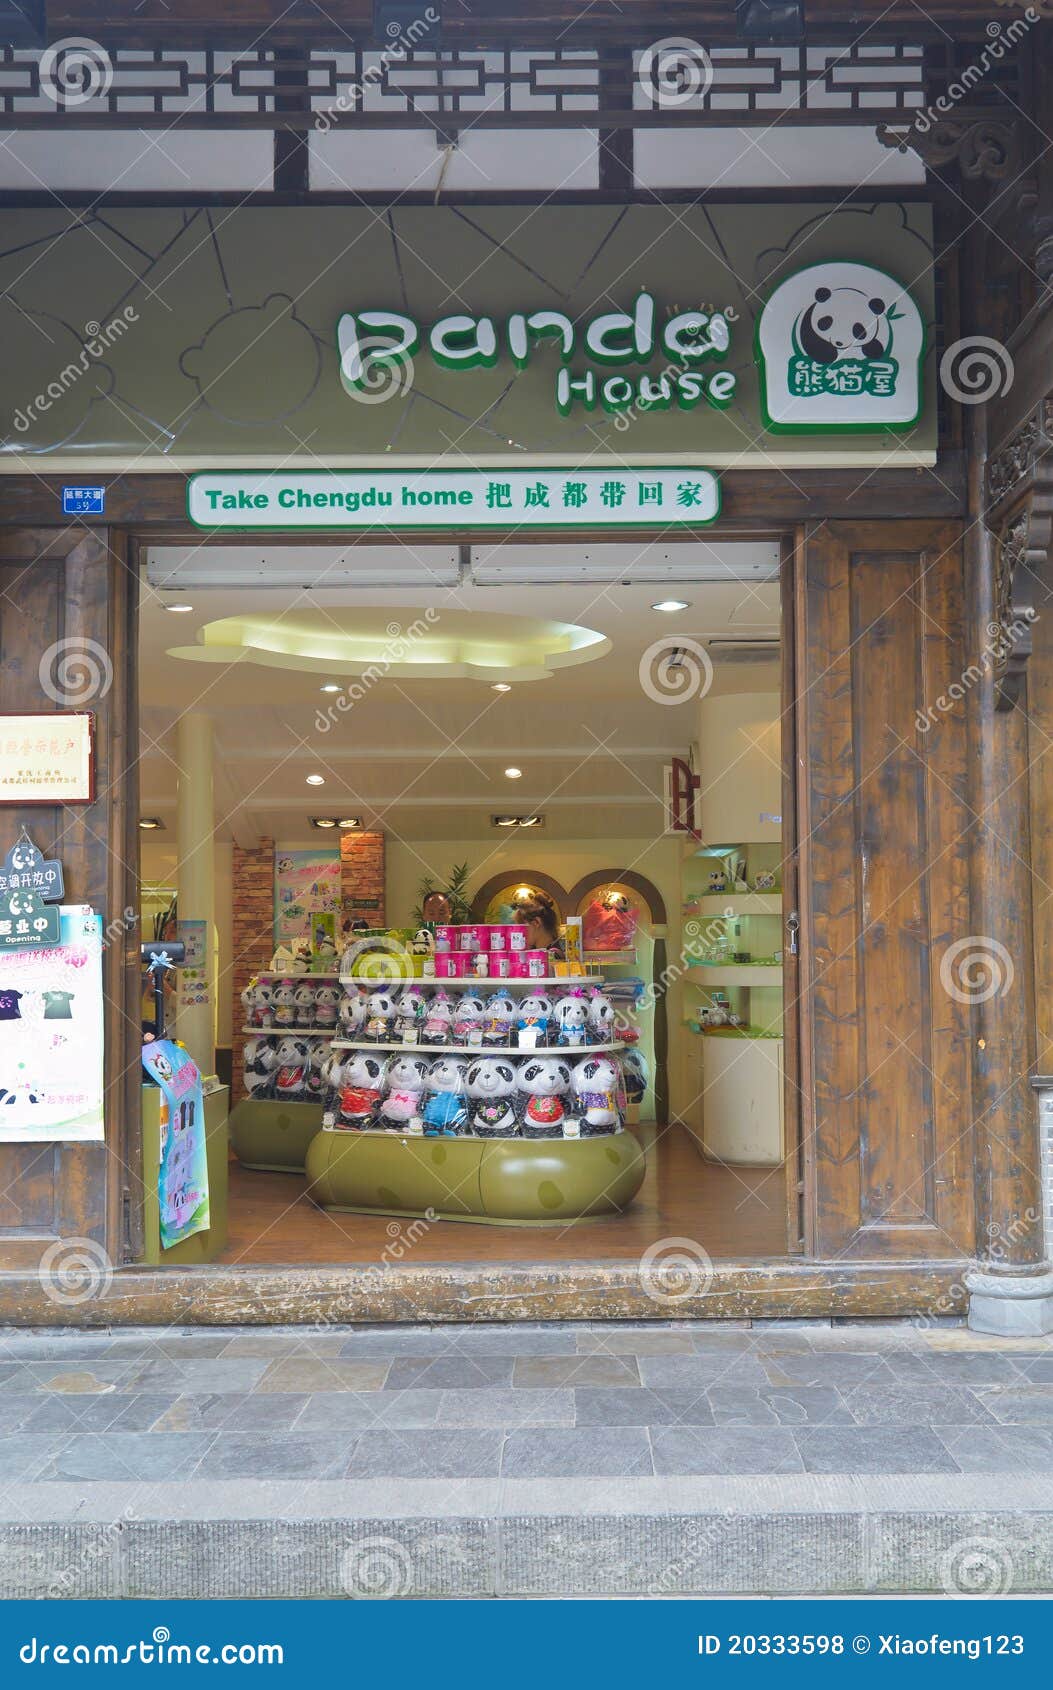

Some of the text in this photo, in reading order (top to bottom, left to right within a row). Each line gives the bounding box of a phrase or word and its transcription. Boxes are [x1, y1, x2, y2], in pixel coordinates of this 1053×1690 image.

[794, 361, 895, 394] 熊猫屋
[204, 486, 474, 513] Take Chengdu home
[484, 481, 704, 509] 把成都带回家
[5, 935, 42, 943] Opening
